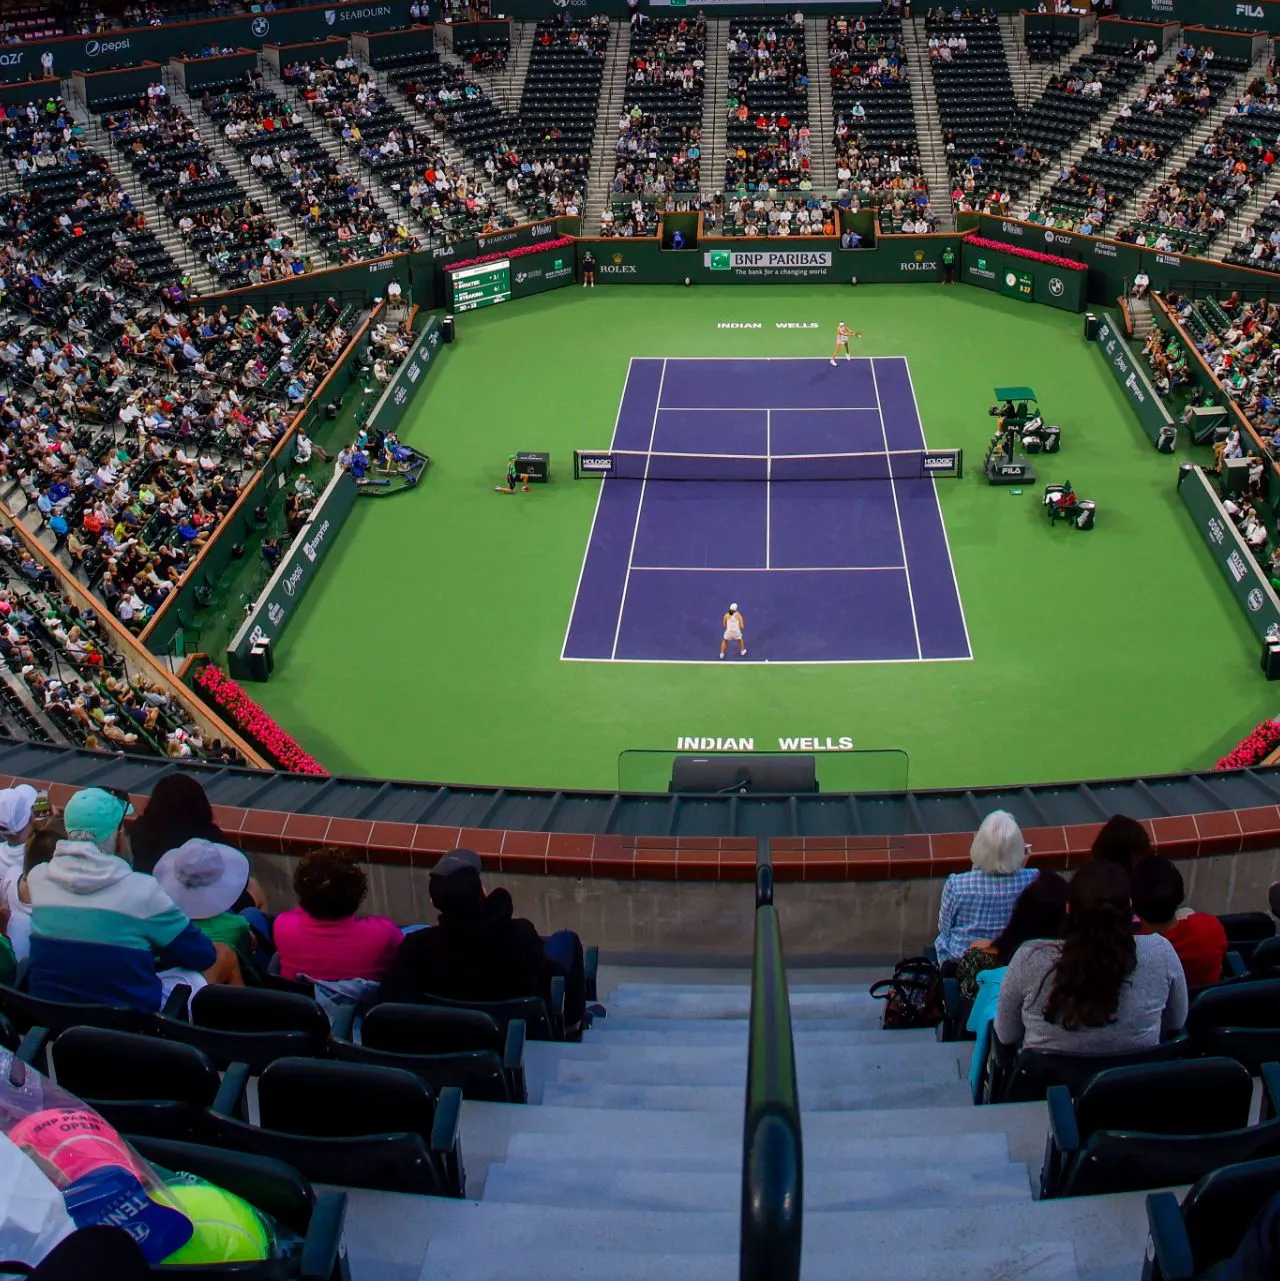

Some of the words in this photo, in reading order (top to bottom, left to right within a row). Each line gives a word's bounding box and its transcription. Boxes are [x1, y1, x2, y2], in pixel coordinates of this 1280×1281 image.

[340, 6, 391, 20] SEABOURN
[1236, 4, 1265, 18] FILA
[101, 38, 130, 53] pepsi
[1055, 235, 1072, 244] razr
[432, 246, 454, 258] FILA
[735, 254, 762, 265] BNP
[769, 253, 827, 265] PARIBAS
[600, 265, 637, 273] ROLEX
[900, 262, 936, 270] ROLEX
[1002, 467, 1021, 475] FILA
[1208, 517, 1224, 545] DOBEL
[303, 520, 330, 562] enterprise
[290, 563, 303, 588] pepsi
[676, 736, 754, 750] INDIAN
[778, 736, 853, 750] WELLS
[33, 1118, 58, 1133] BNP
[60, 1122, 101, 1132] OPEN
